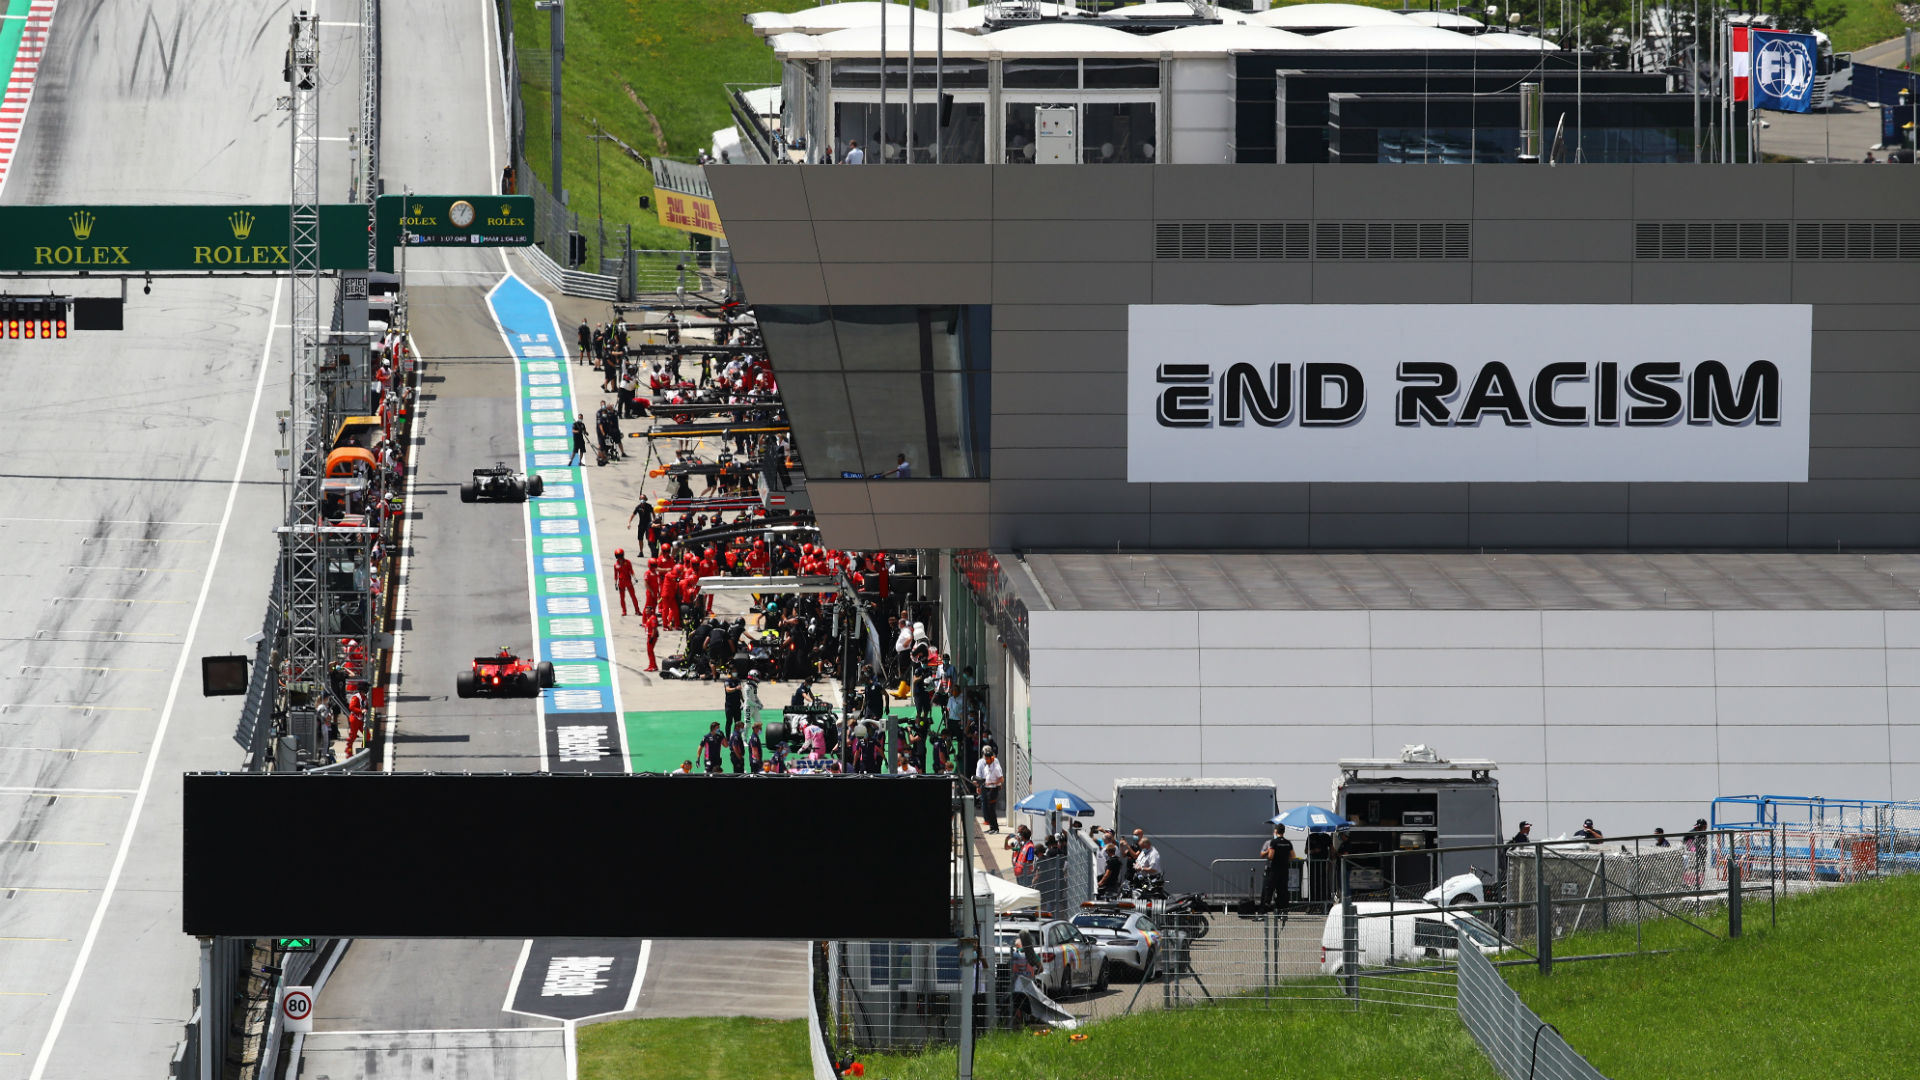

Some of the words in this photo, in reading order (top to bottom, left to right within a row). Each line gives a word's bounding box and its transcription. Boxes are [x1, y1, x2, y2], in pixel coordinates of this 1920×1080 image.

[487, 217, 525, 226] ROLEX
[34, 246, 131, 265] ROLEX
[193, 246, 290, 265] ROLEX
[345, 285, 365, 293] BERG
[1156, 361, 1368, 427] END
[1395, 360, 1783, 428] RACISM
[288, 999, 307, 1012] 80
